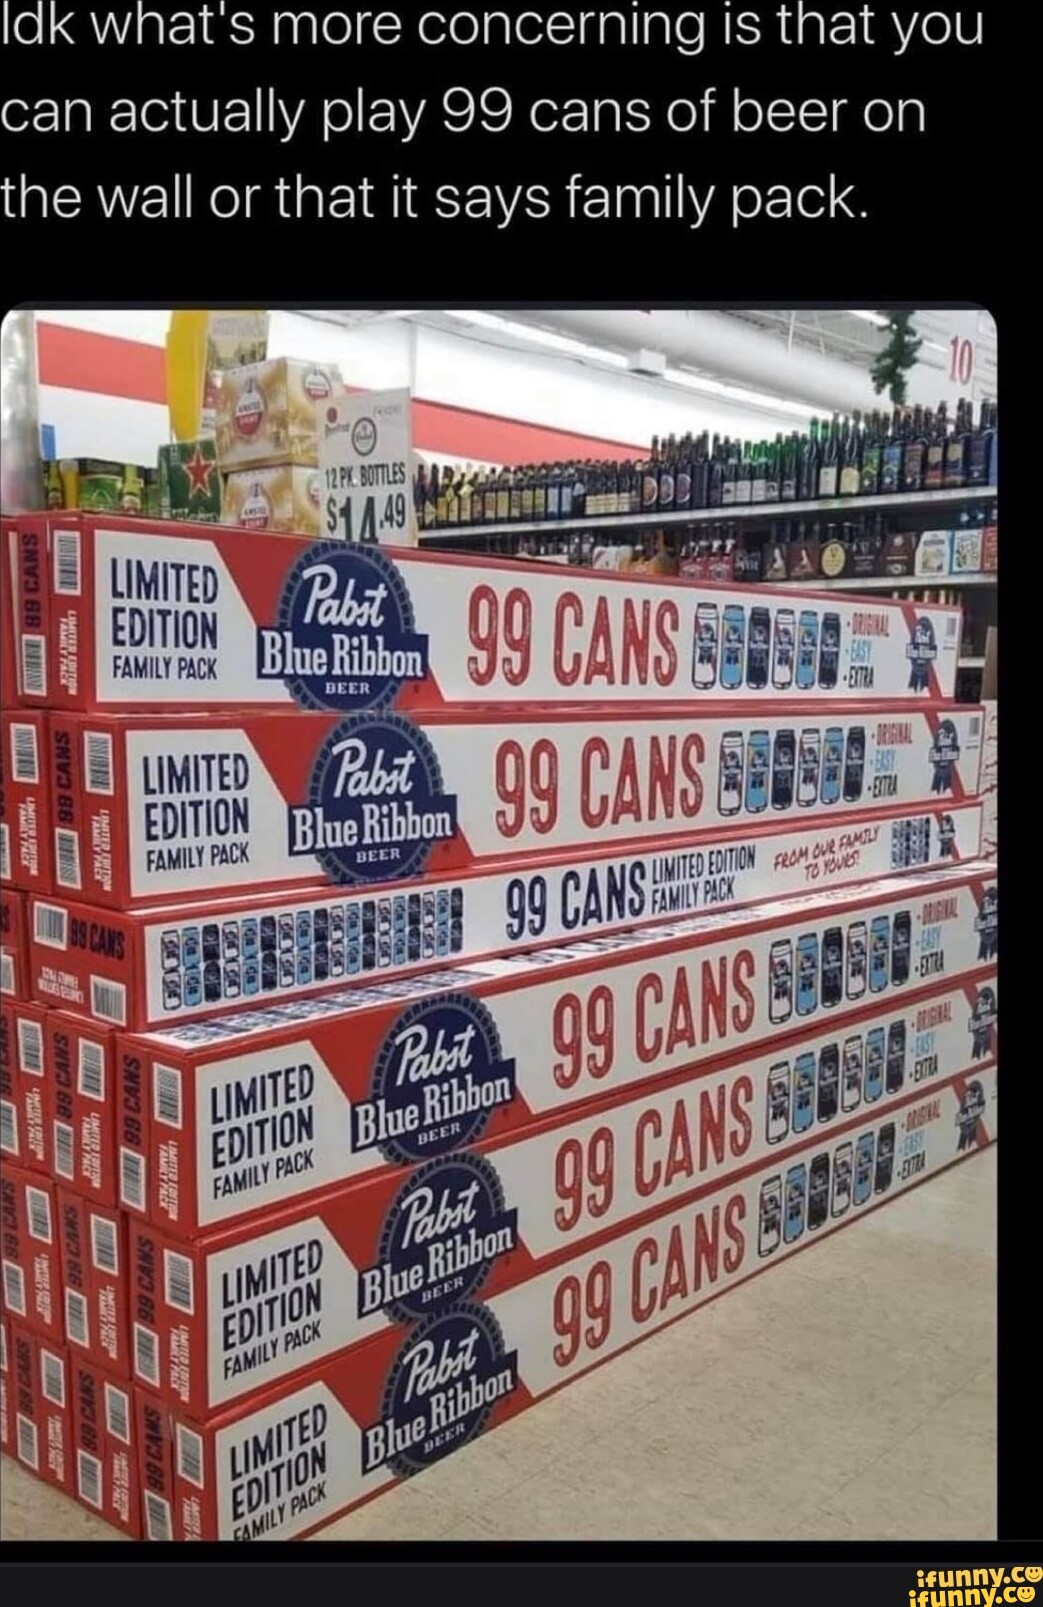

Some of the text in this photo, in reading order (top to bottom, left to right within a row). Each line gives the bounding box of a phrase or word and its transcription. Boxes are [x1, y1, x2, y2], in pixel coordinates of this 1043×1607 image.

[949, 335, 973, 386] 10
[325, 467, 338, 489] 12
[360, 462, 406, 487] BOTTLES
[111, 557, 219, 604] LIMITED
[303, 563, 388, 627] Pabst
[112, 606, 218, 650] EDITION
[467, 584, 679, 688] 99 CANS
[113, 655, 218, 681] FAMILY PACK
[261, 630, 424, 678] Blue Ribbon
[848, 665, 875, 689] EXTRA
[325, 681, 370, 695] BEER
[142, 753, 249, 796] LIMITED
[331, 737, 417, 798] Pabst
[495, 732, 706, 838] 99 CANS
[872, 774, 897, 798] EXTRA
[144, 797, 250, 842] EDITION
[292, 802, 453, 853] Blue Ribbon
[146, 842, 250, 873] FAMILY PACK
[356, 847, 401, 864] BEER
[652, 844, 756, 885] LIMITED EDITION
[773, 826, 881, 872] FROM OUR FAMILY
[804, 864, 821, 881] TO
[505, 860, 647, 940] 99 CANS
[651, 875, 735, 915] FAMILY PACK
[919, 950, 945, 977] EXTRA
[552, 948, 756, 1090] 99 CANS
[395, 1023, 475, 1085] Pabst
[914, 1055, 938, 1082] EXTRA
[211, 1063, 315, 1126] LIMITED
[355, 1074, 512, 1148] Blue Ribbon
[212, 1105, 314, 1170] EDITION
[417, 1123, 461, 1146] BEER
[554, 1075, 754, 1232] 99 CANS
[213, 1148, 315, 1200] FAMILY PACK
[902, 1151, 927, 1180] EXTRA
[401, 1180, 480, 1250] Pabst
[222, 1238, 324, 1310] LIMITED
[361, 1225, 514, 1314] Blue Ribbon
[421, 1276, 464, 1303] BEER
[552, 1193, 747, 1368] 99 CANS
[222, 1279, 322, 1352] EDITION
[223, 1335, 279, 1381] FAMILY
[284, 1320, 322, 1355] PACK
[402, 1327, 480, 1405] Pabst
[230, 1402, 328, 1481] LIMITED
[366, 1367, 514, 1470] Blue Ribbon
[423, 1423, 467, 1454] BEER
[232, 1440, 327, 1522] EDITION
[290, 1481, 328, 1518] PACK
